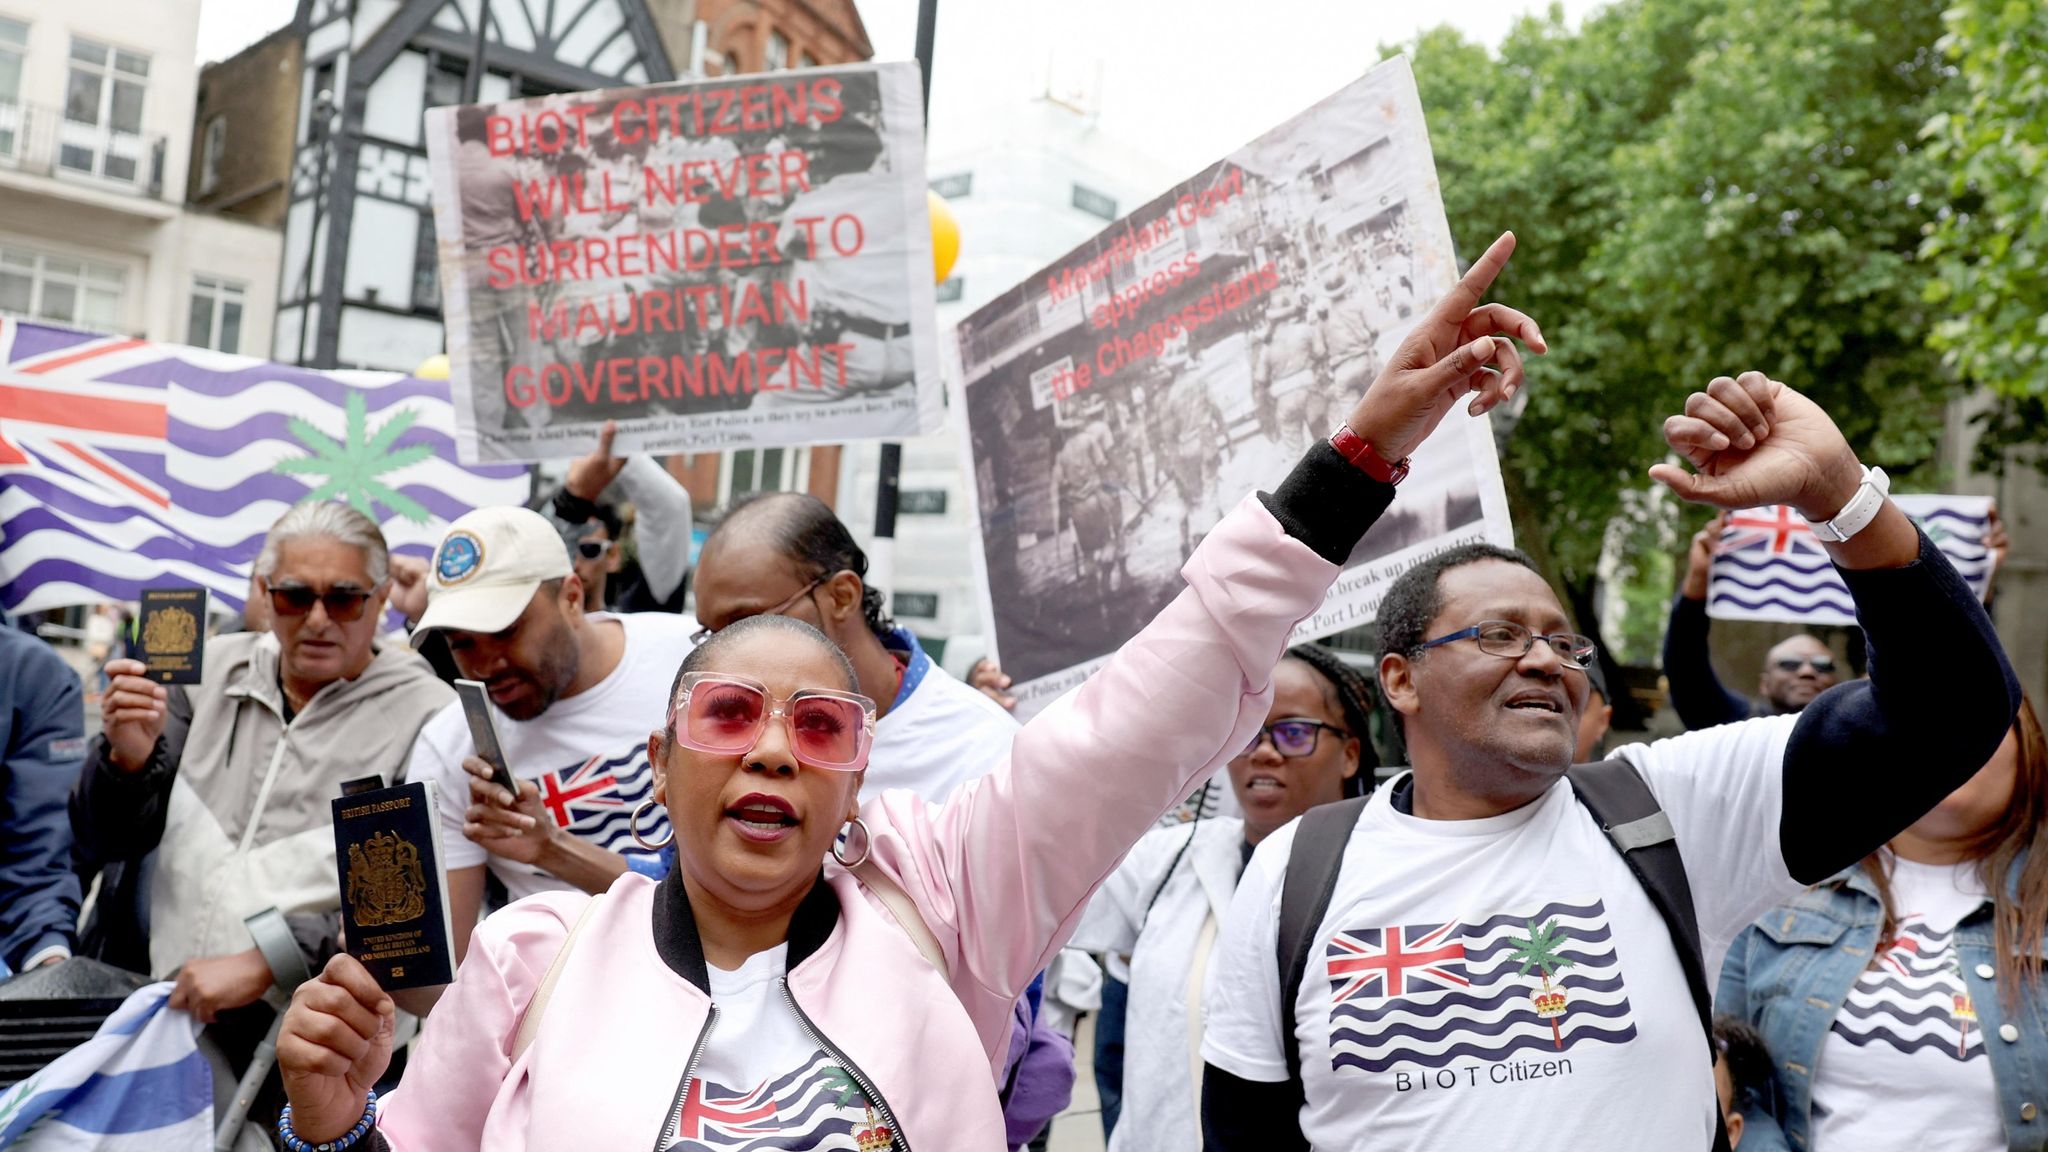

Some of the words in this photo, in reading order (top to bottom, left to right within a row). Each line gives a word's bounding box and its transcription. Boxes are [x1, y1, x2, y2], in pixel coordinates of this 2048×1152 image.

[485, 104, 597, 157] BIOT
[612, 78, 845, 145] CITIZENS
[512, 170, 631, 222] WILL
[644, 150, 811, 207] NEVER
[486, 221, 782, 290] SURRENDER
[794, 213, 864, 261] TO
[1048, 216, 1169, 304] Mauritian
[1176, 167, 1244, 228] Govt
[527, 279, 809, 342] MAURITIAN
[1052, 362, 1092, 400] the
[1096, 260, 1280, 376] Chagossians
[504, 344, 855, 408] GOVERNMENT
[1337, 569, 1380, 594] break
[1384, 562, 1404, 580] up
[1313, 609, 1344, 631] Port
[341, 805, 371, 819] BRITISH
[371, 797, 412, 814] PASSPORT
[1490, 1058, 1572, 1083] Citizen
